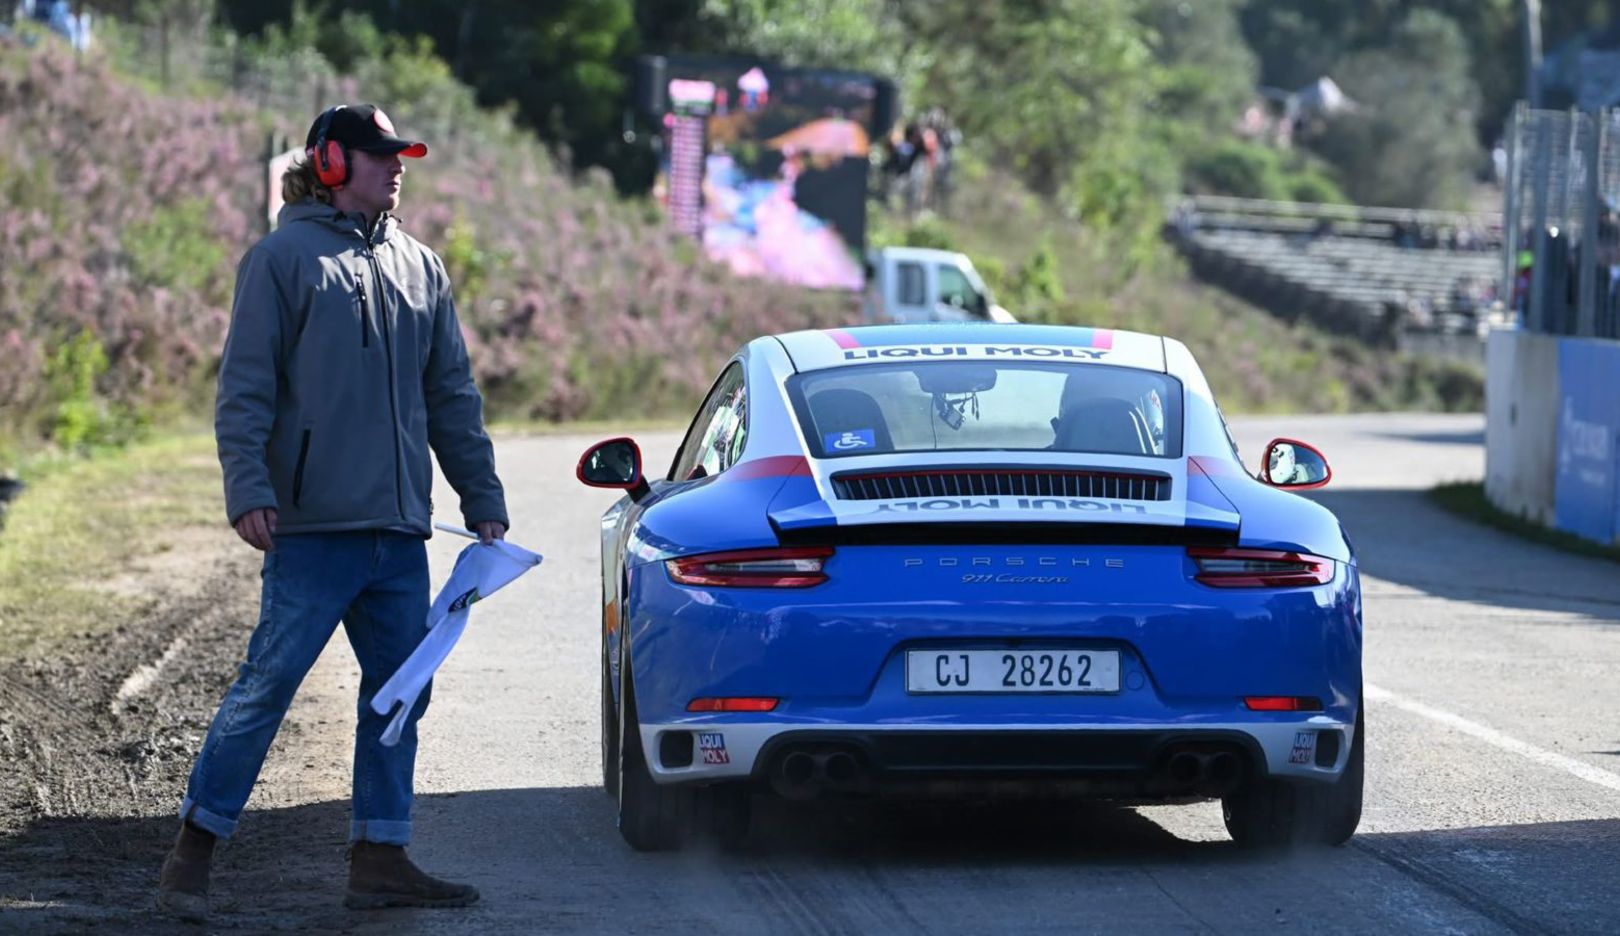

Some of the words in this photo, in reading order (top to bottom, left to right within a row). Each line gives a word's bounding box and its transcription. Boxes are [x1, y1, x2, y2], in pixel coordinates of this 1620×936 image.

[844, 347, 968, 360] LIQUI
[984, 347, 1110, 360] MOLY
[869, 498, 1000, 513] MOLY
[1018, 498, 1147, 514] LIQUI
[904, 557, 1124, 568] PORSCHE
[961, 573, 994, 583] 911
[995, 573, 1069, 583] Carrera
[935, 654, 970, 687] CJ
[1001, 654, 1092, 687] 28262
